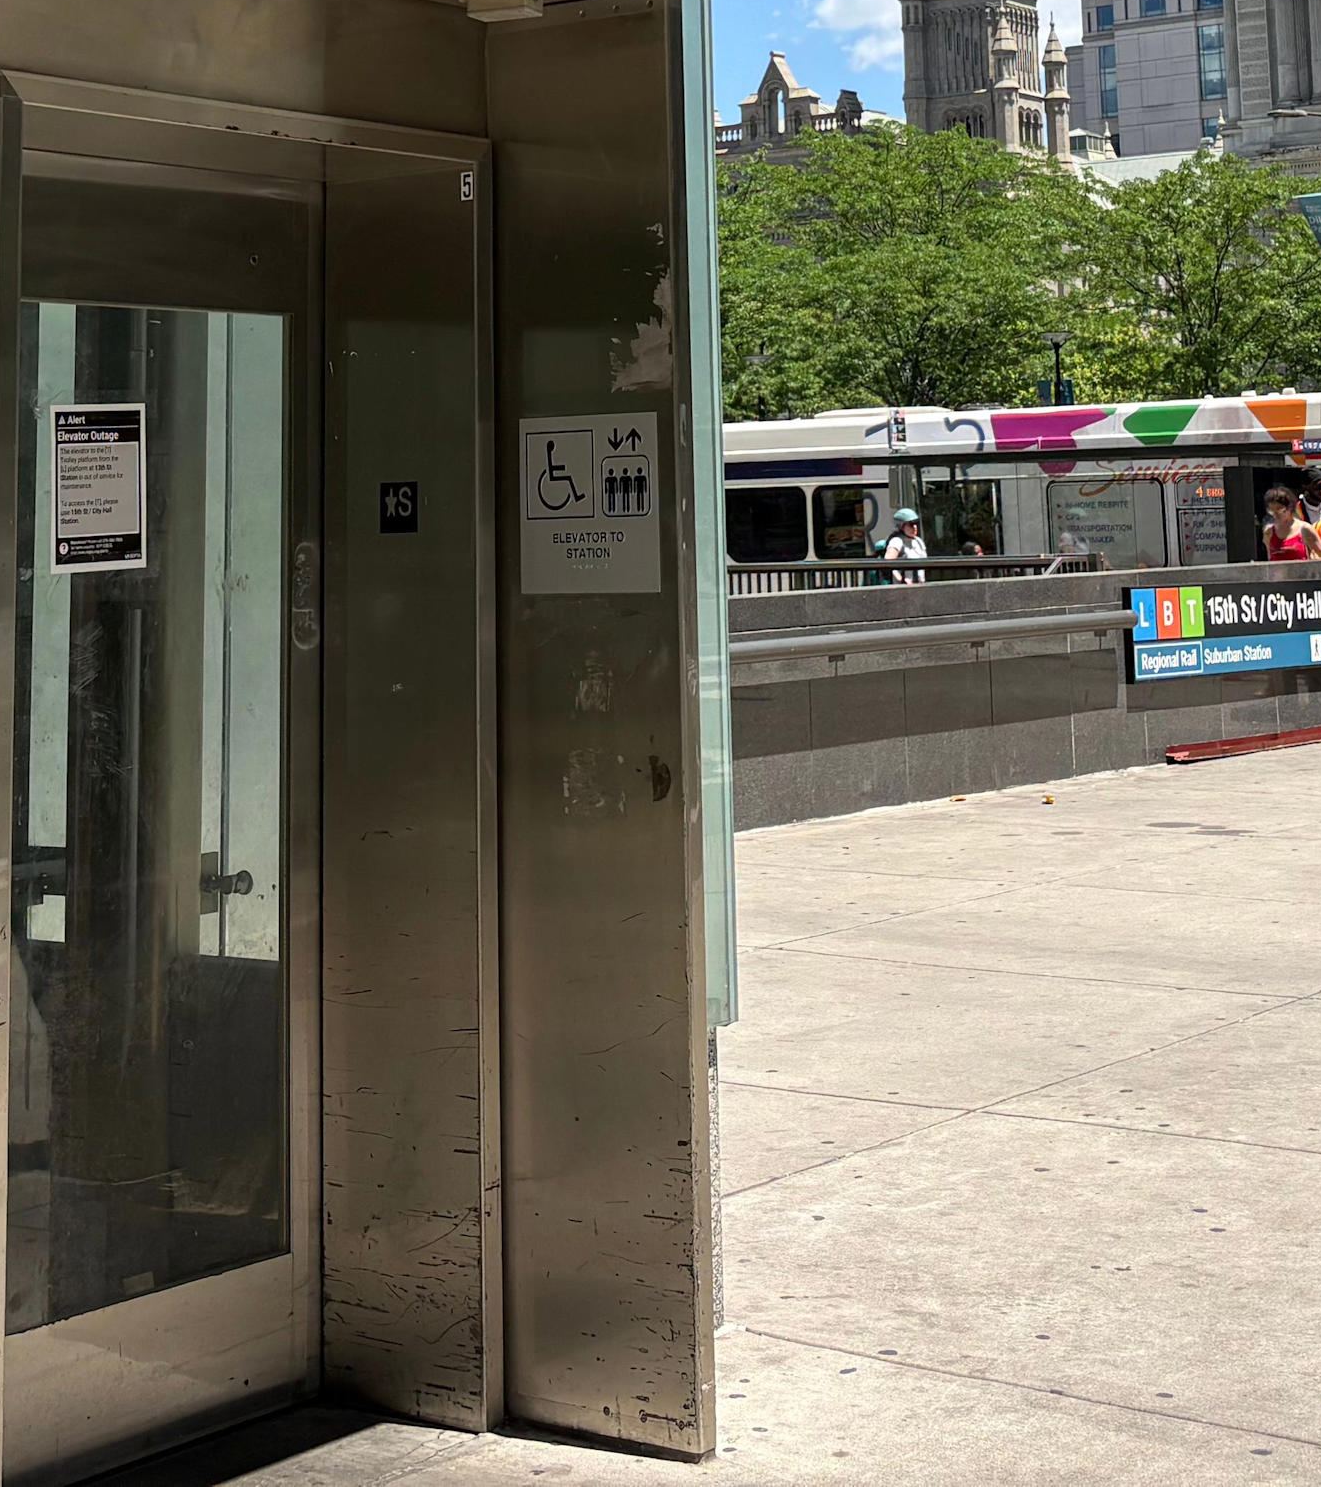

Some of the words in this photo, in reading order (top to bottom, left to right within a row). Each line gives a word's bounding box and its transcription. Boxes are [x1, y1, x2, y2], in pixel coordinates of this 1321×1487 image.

[462, 174, 472, 199] 5
[67, 415, 86, 425] Alert
[58, 431, 89, 441] Elevator
[91, 431, 119, 442] Outage
[1195, 485, 1204, 498] 4
[552, 530, 608, 545] ELEVATOR
[610, 529, 625, 543] TO
[566, 545, 611, 559] STATION
[1139, 601, 1149, 628] L
[1163, 600, 1174, 626] B
[1186, 599, 1197, 625] T
[1206, 594, 1238, 625] 15th
[1240, 595, 1257, 624] St
[1259, 597, 1266, 624] /
[1266, 593, 1294, 629] City
[1141, 650, 1179, 674] Regional
[1180, 648, 1197, 666] Rail
[1203, 646, 1243, 665] Suburban
[1243, 644, 1272, 662] Station
